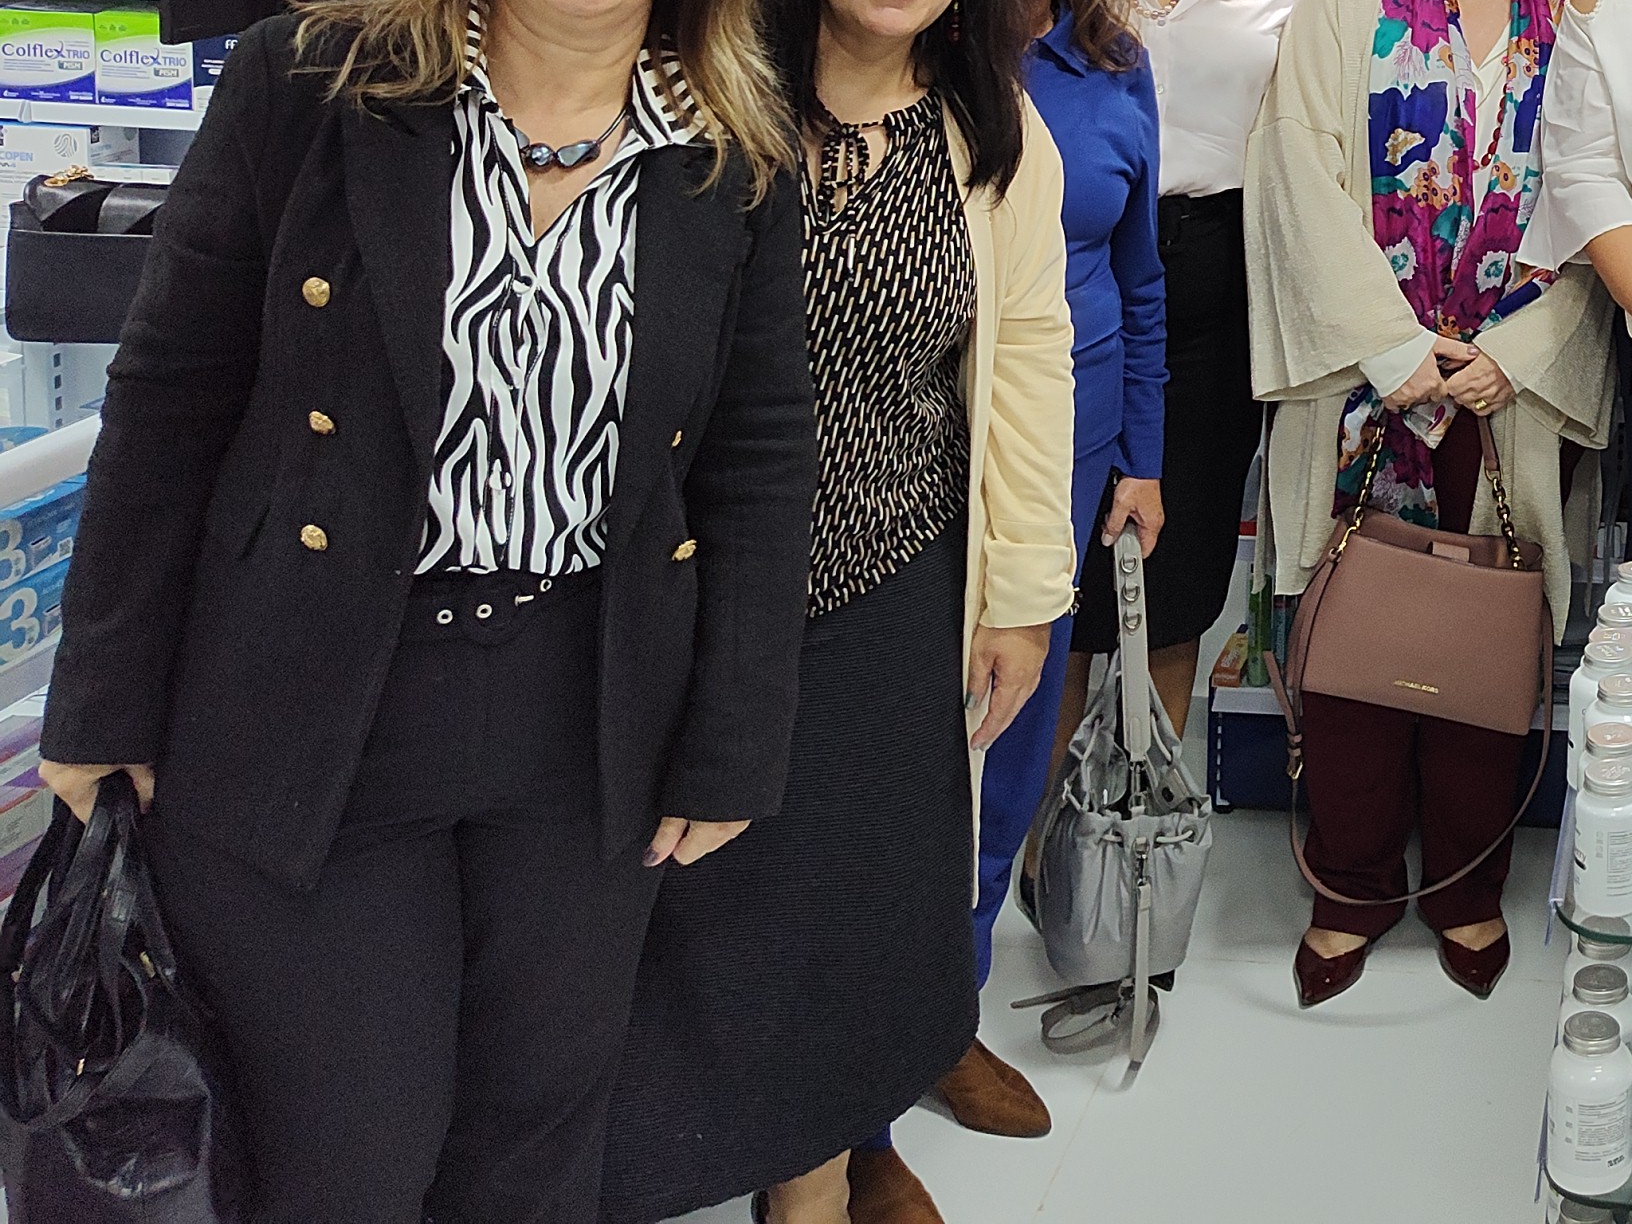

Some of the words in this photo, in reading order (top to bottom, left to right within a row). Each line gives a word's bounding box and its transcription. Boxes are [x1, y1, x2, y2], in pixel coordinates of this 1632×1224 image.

[2, 41, 65, 59] Colflex
[66, 49, 90, 60] TRIO
[100, 48, 162, 66] Colflex
[163, 57, 187, 67] TRIO
[0, 589, 39, 651] 3
